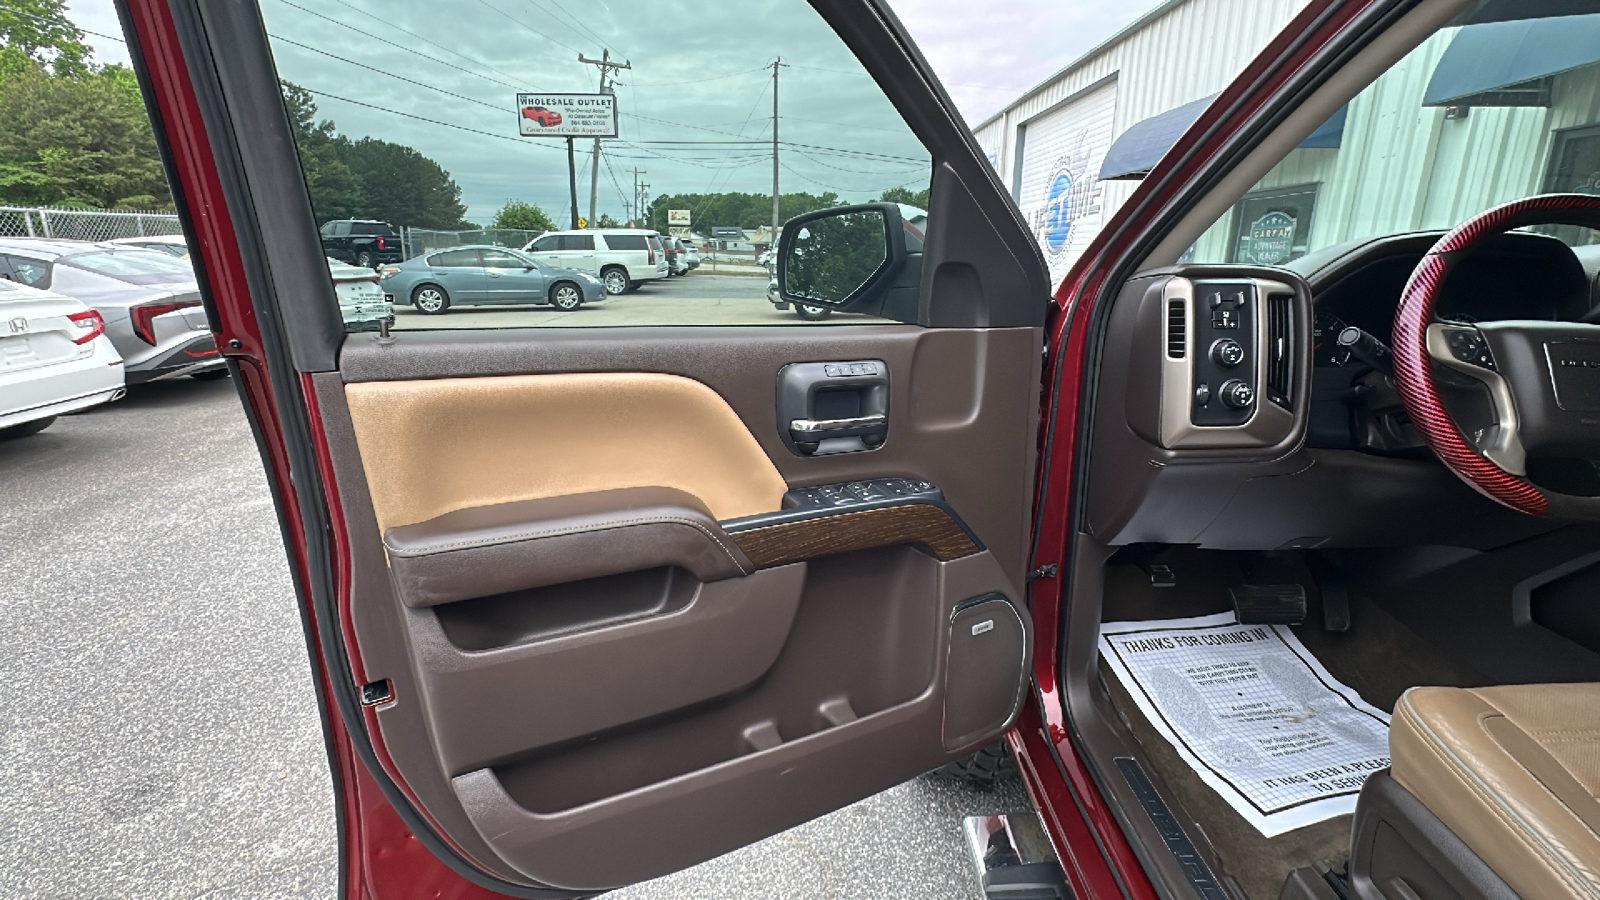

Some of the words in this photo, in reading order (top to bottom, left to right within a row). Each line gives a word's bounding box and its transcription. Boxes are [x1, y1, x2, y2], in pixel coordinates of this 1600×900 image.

[519, 98, 574, 106] WHOLESALE
[1121, 637, 1176, 654] THANKS
[1173, 635, 1203, 648] FOR
[1201, 631, 1253, 646] COMING
[1252, 628, 1270, 641] IN
[1263, 779, 1278, 789] IT
[1277, 774, 1308, 788] HAS
[1306, 766, 1344, 781] BEEN
[1341, 764, 1356, 774] A
[1353, 757, 1391, 771] PLEAS
[1311, 782, 1333, 793] TO
